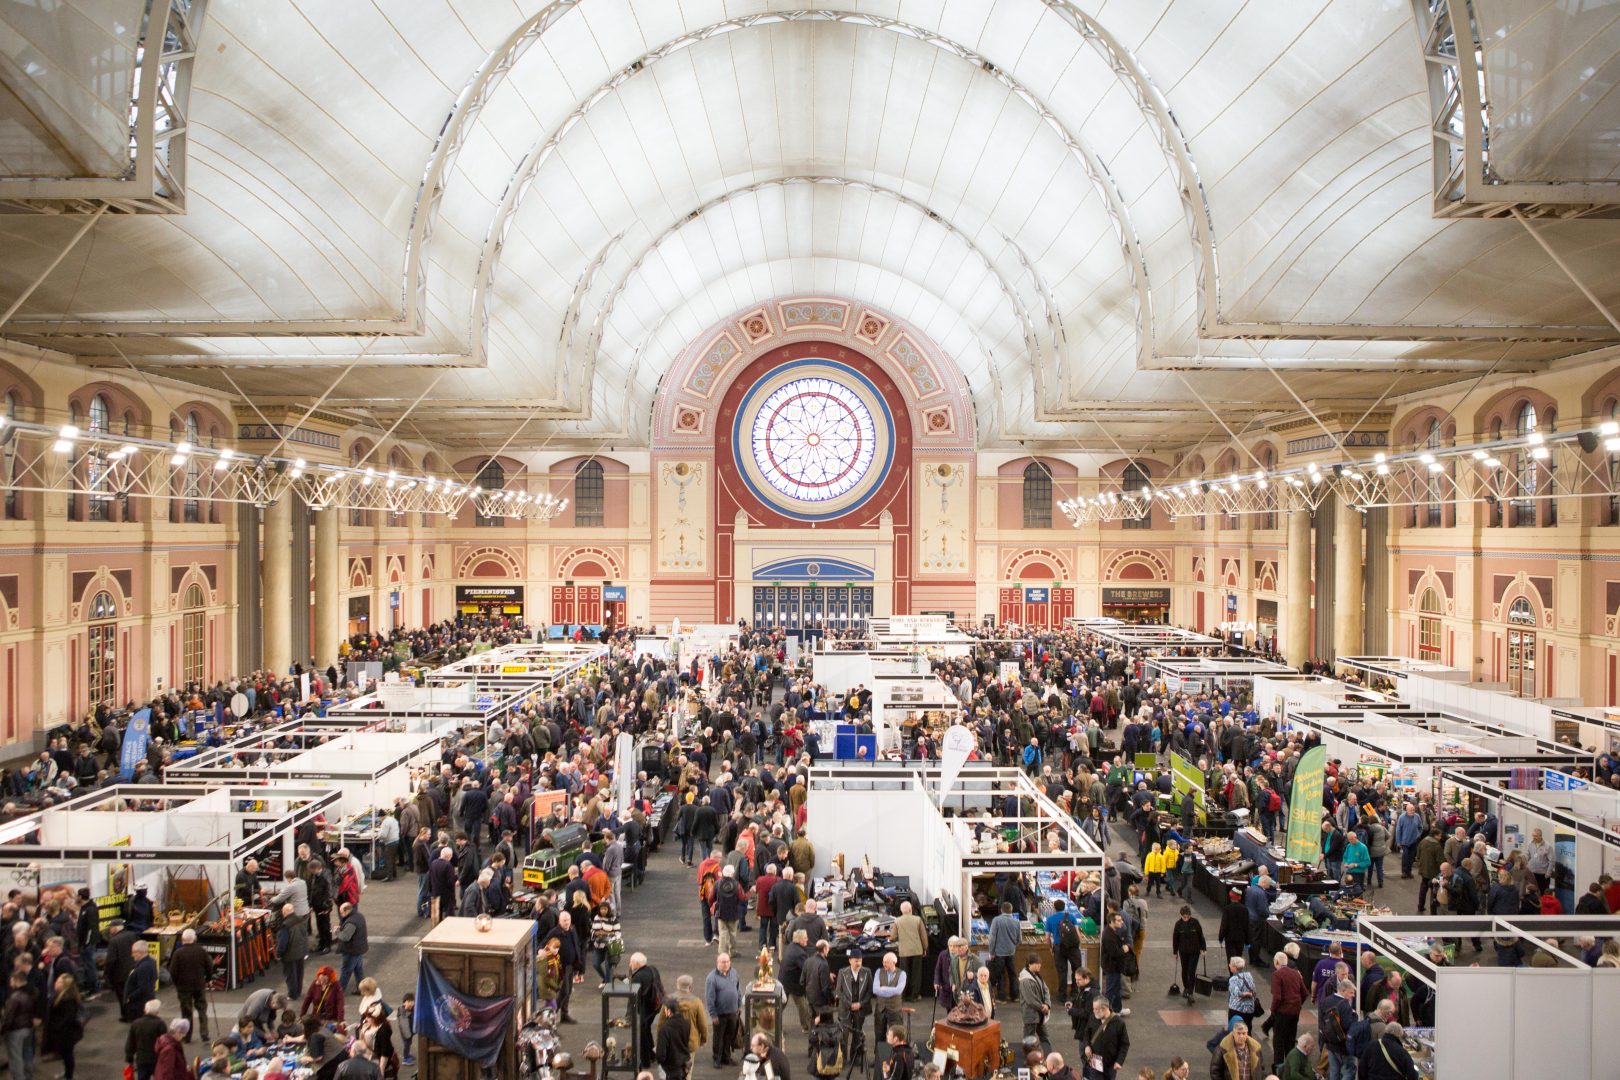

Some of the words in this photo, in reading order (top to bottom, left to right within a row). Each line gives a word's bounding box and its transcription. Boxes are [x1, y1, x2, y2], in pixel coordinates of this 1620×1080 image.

[1111, 590, 1126, 598] THE
[1127, 590, 1164, 598] BREWERS
[1221, 621, 1255, 632] PIZZA
[1292, 808, 1319, 823] SME
